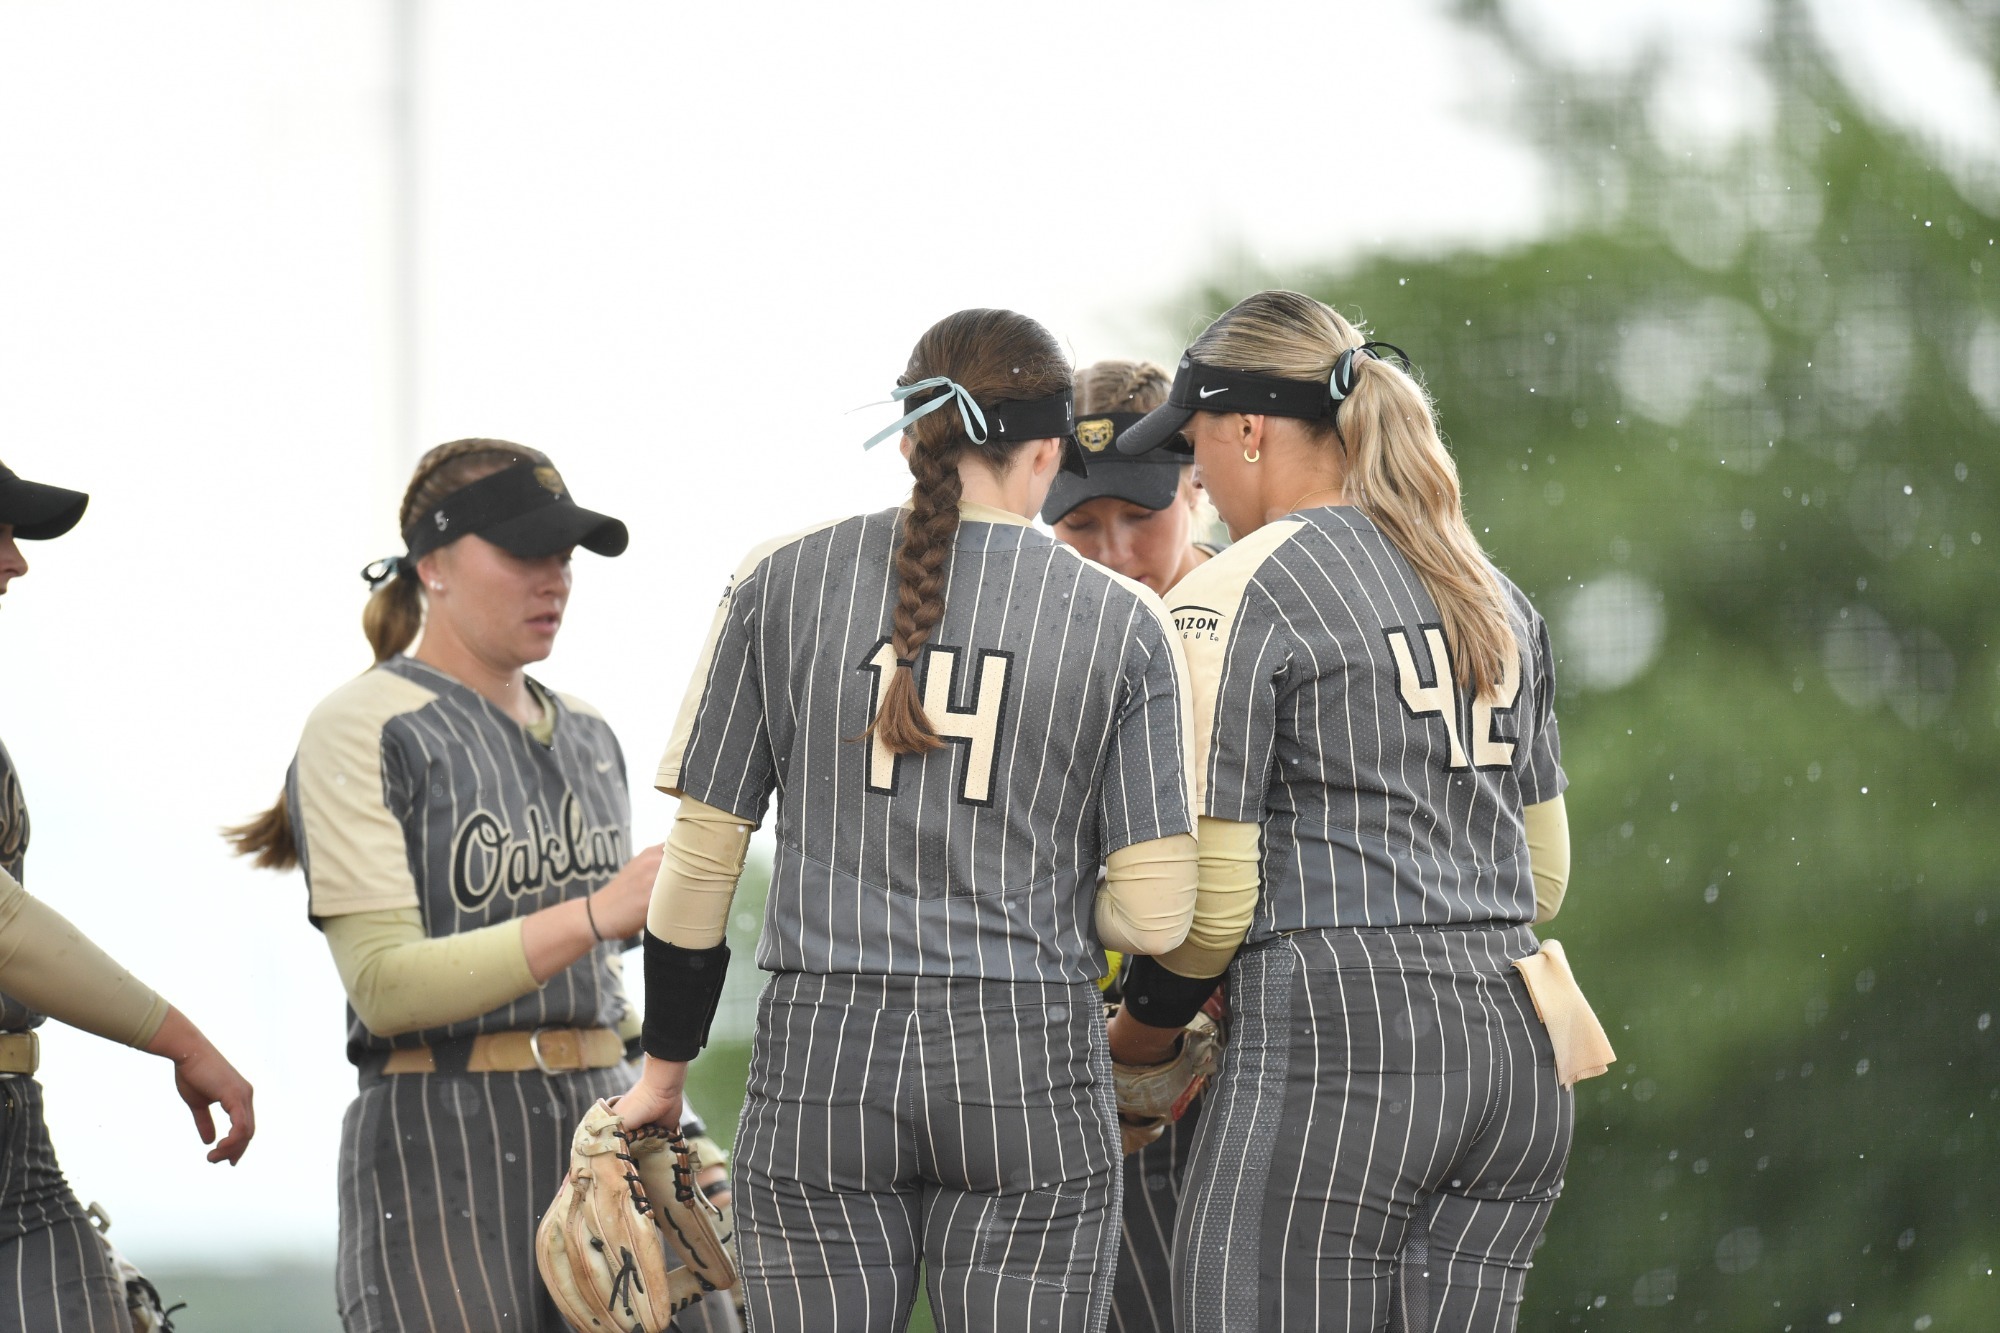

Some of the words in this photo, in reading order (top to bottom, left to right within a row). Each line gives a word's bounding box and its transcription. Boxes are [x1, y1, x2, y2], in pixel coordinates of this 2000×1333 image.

[434, 510, 448, 531] 5
[856, 636, 1015, 808] 14
[1381, 623, 1523, 773] 42
